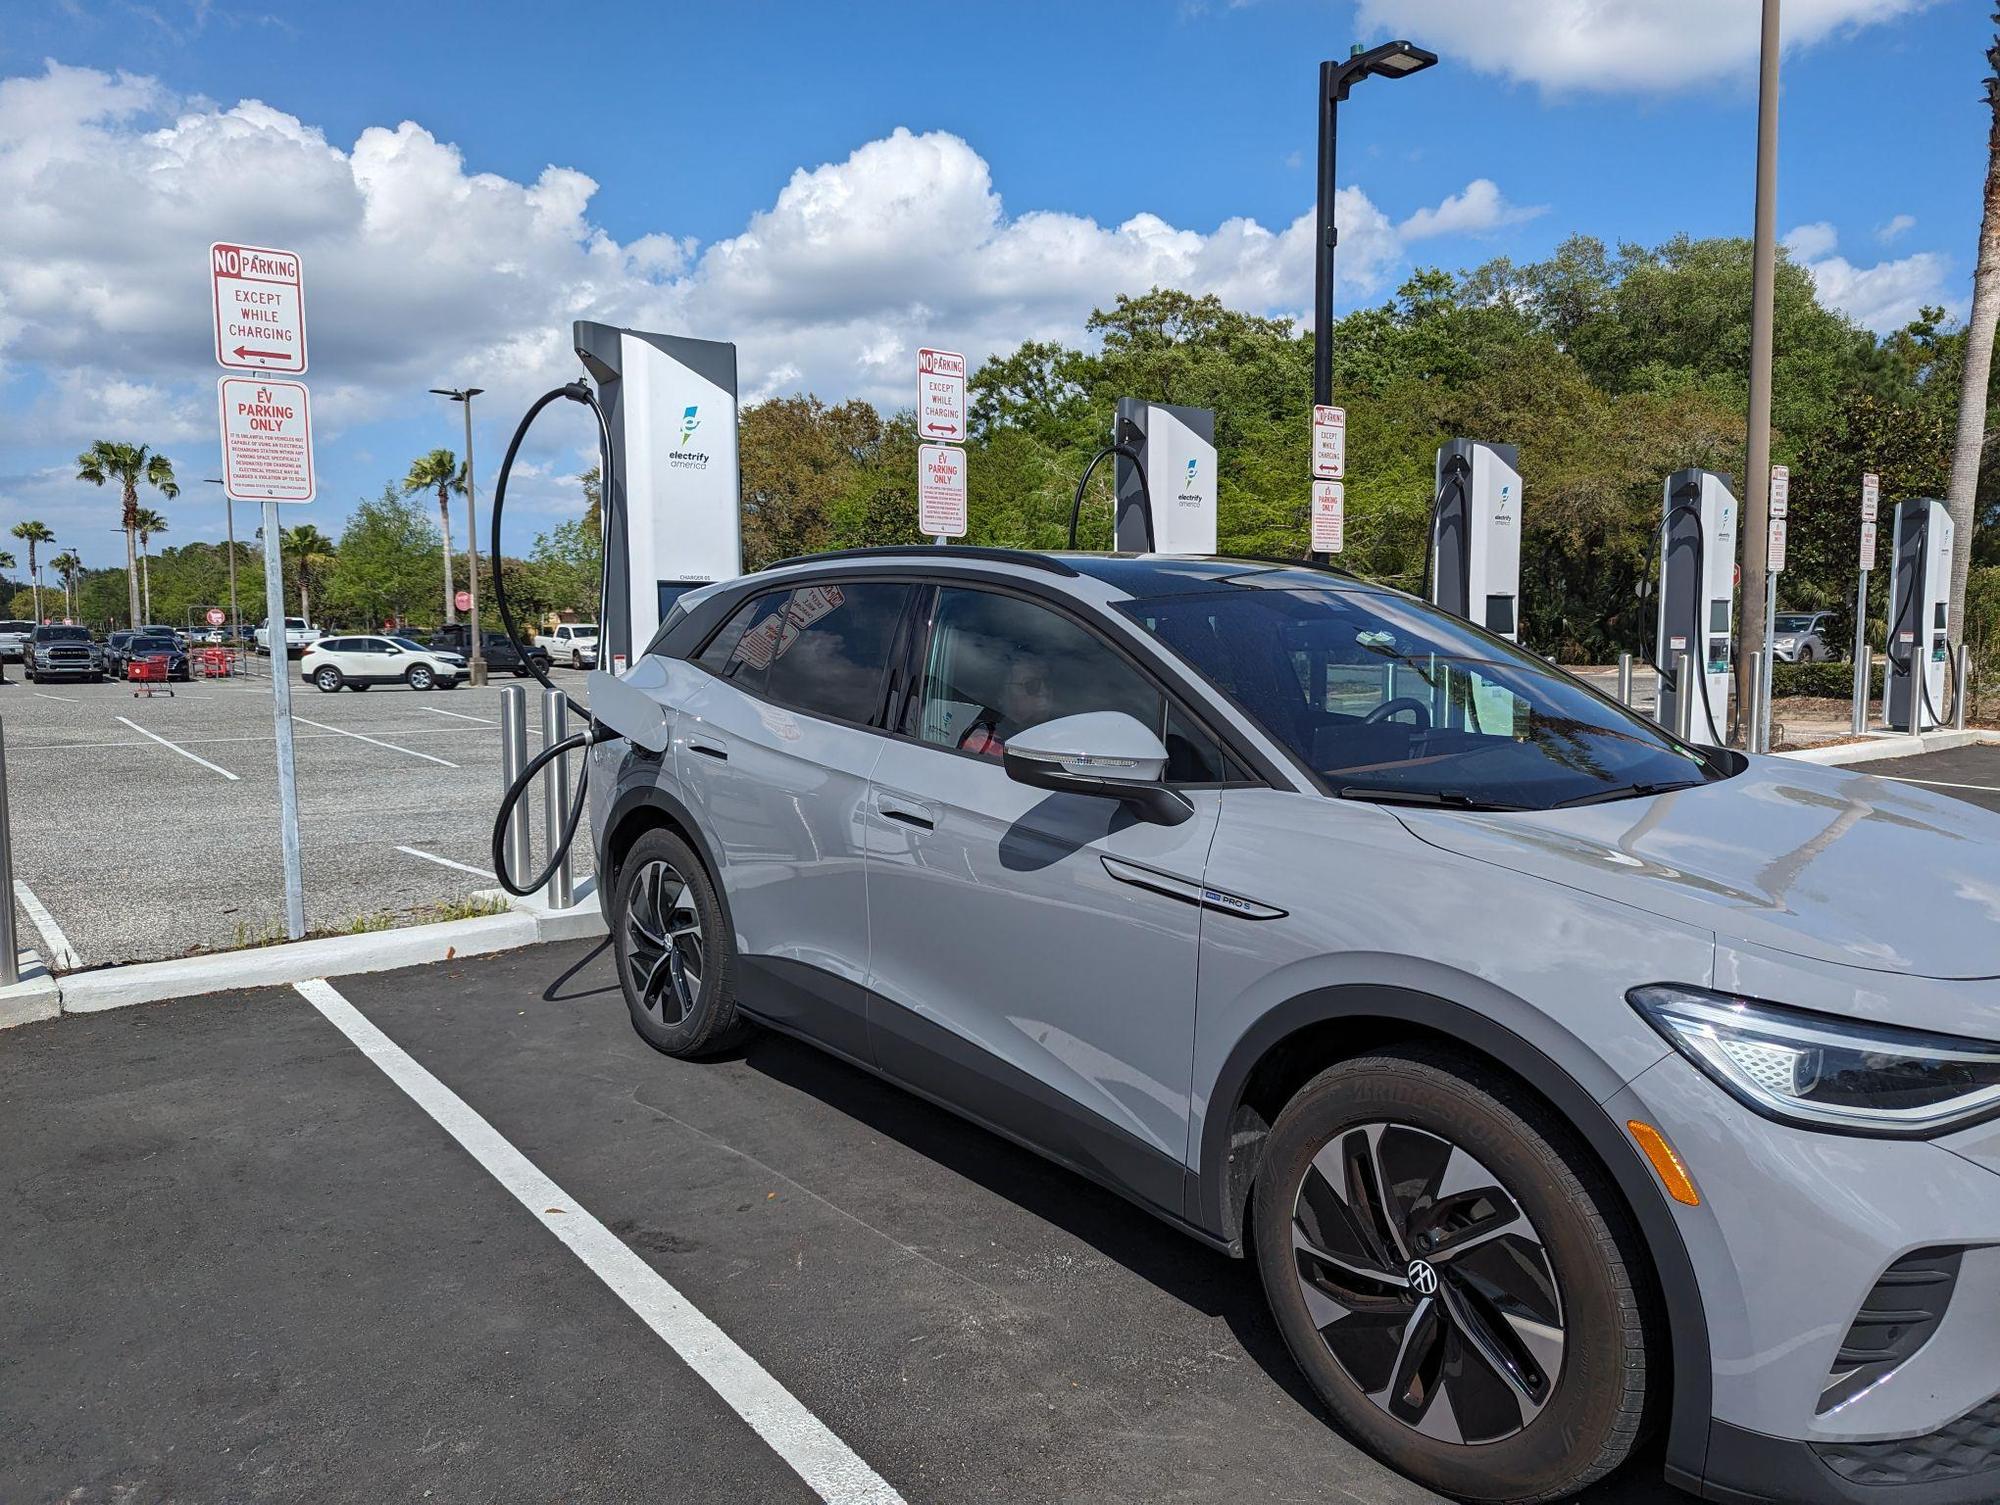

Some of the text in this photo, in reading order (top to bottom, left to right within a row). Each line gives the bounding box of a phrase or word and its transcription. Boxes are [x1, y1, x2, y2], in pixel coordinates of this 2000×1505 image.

[215, 250, 295, 278] NO PARKING
[235, 290, 281, 305] EXCEPT
[241, 308, 279, 322] WHILE
[229, 324, 292, 341] CHARGING
[920, 353, 962, 373] NO PARKING
[929, 382, 954, 393] EXCEPT
[257, 390, 272, 404] EV
[932, 395, 952, 405] WHILE
[238, 403, 293, 419] PARKING
[925, 407, 959, 419] CHARGING
[250, 418, 283, 432] ONLY
[669, 451, 709, 463] electrify
[939, 455, 947, 464] EV
[671, 460, 706, 470] america
[928, 464, 957, 475] PARKING
[934, 475, 952, 485] ONLY
[1222, 896, 1242, 907] PRO
